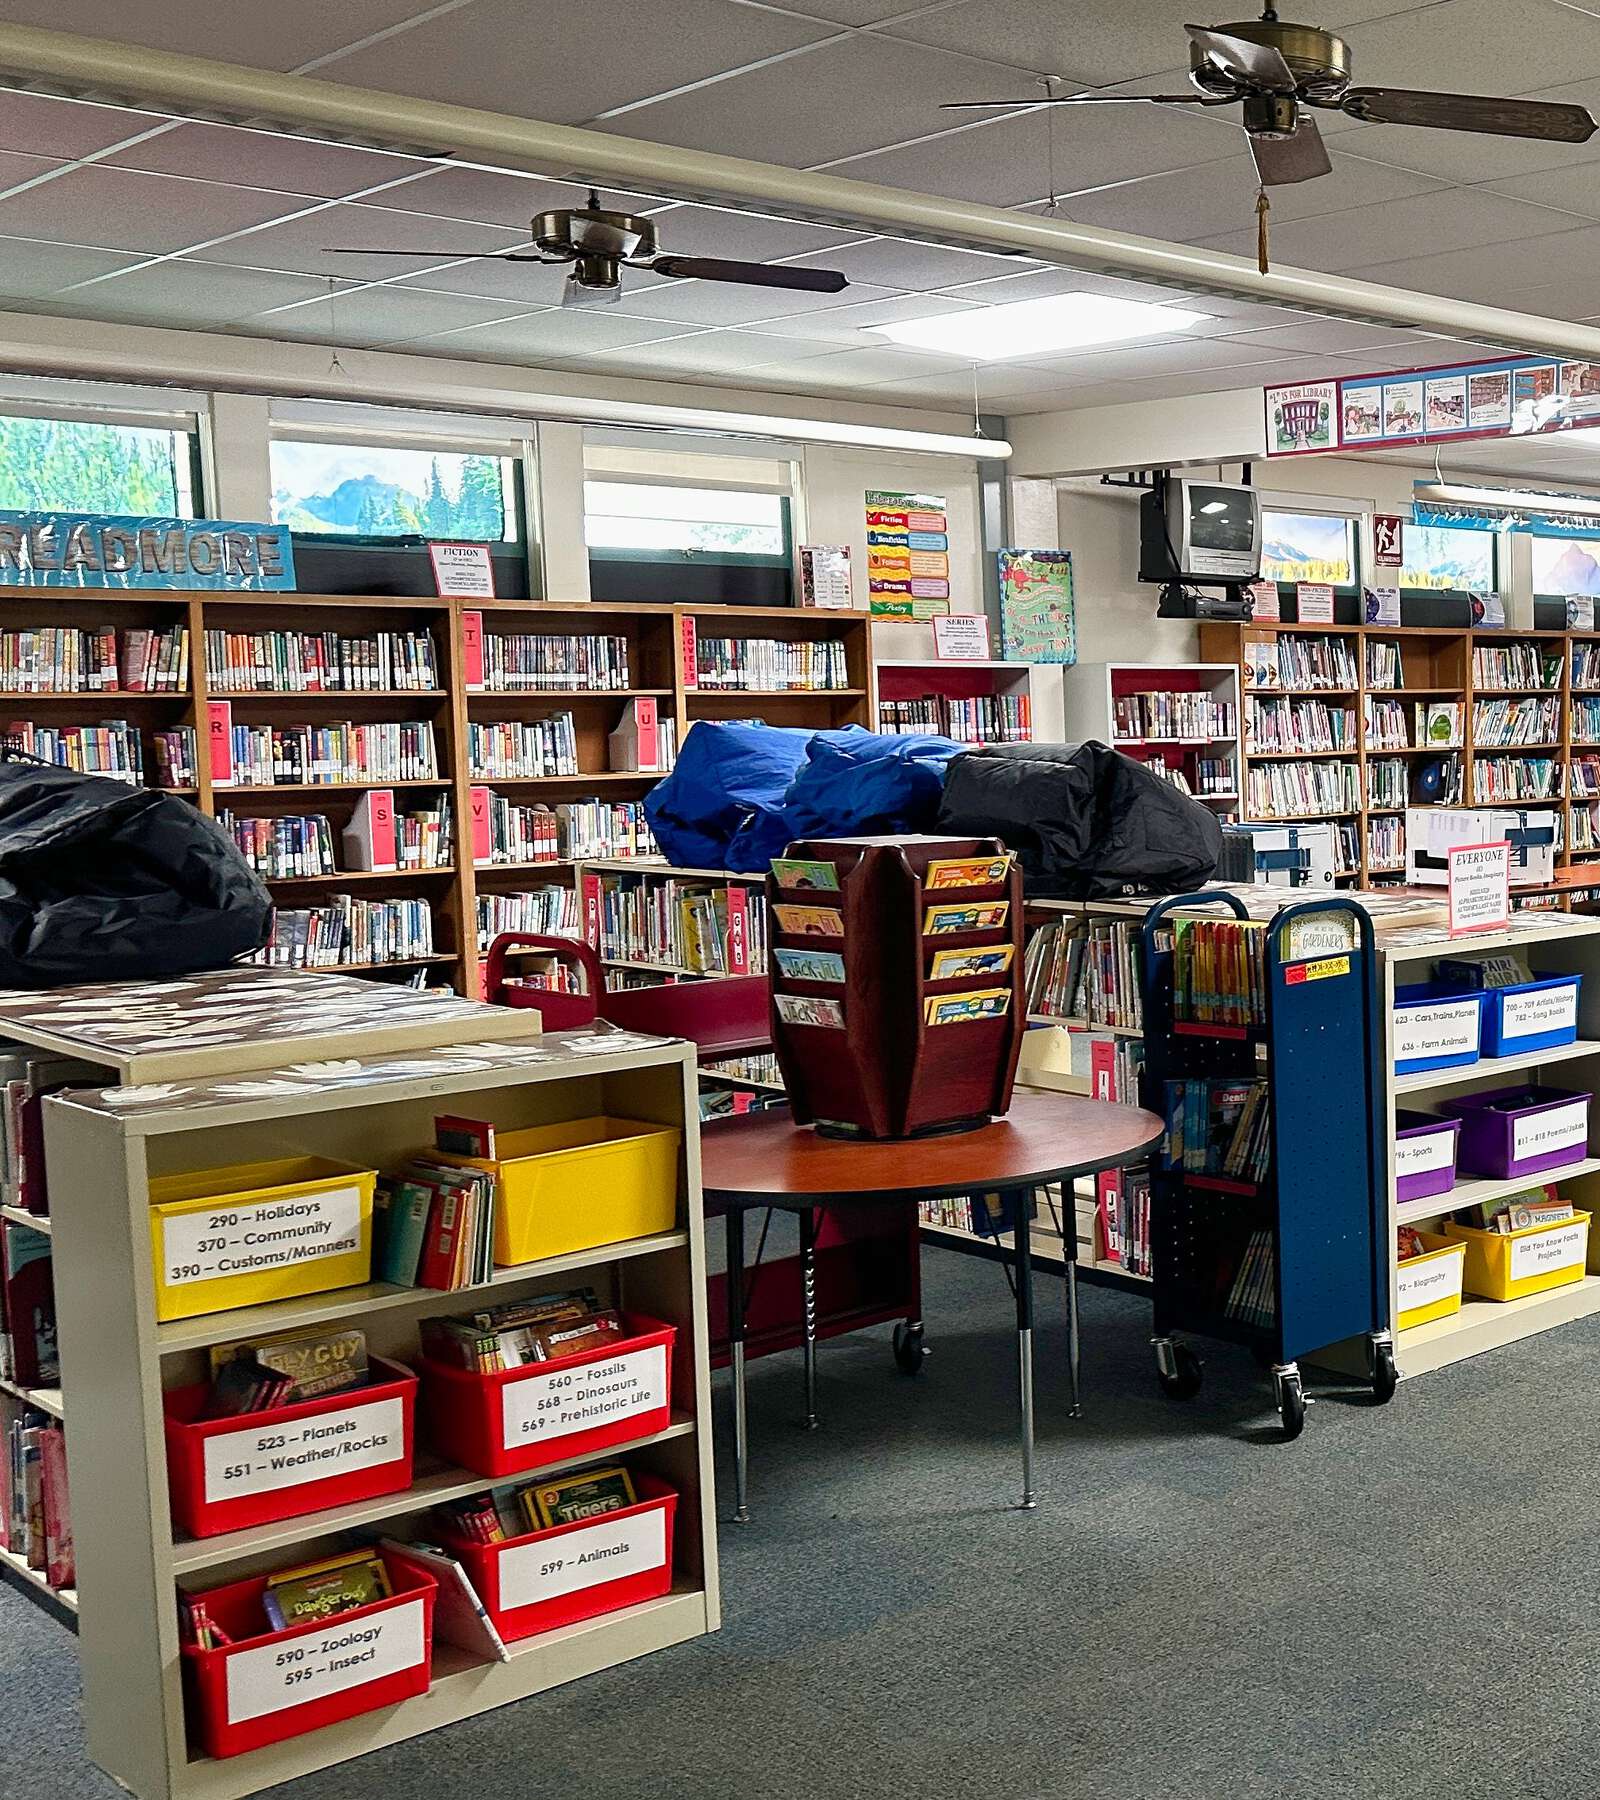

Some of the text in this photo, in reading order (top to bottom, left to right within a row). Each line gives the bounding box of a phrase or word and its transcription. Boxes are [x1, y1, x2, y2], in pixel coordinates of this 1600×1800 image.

[1281, 391, 1288, 399] IS
[1289, 389, 1302, 398] FOR
[1303, 387, 1333, 398] LIBRARY
[881, 516, 903, 524] Fiction
[443, 548, 479, 557] FICTION
[466, 630, 475, 640] T
[211, 721, 222, 733] R
[641, 714, 650, 725] U
[377, 809, 386, 821] S
[473, 805, 482, 816] V
[1456, 849, 1504, 865] EVERYONE
[789, 958, 816, 979] JACK
[784, 1000, 813, 1023] JACK
[1506, 1003, 1518, 1012] 700
[1549, 1007, 1565, 1016] Books
[1395, 1016, 1408, 1025] 623
[1422, 1039, 1439, 1049] Farm
[1441, 1036, 1468, 1047] Animals
[1222, 1093, 1248, 1102] Denti
[1547, 1121, 1585, 1139] Poems/Jokes
[1412, 1146, 1432, 1158] Sports
[209, 1201, 321, 1229] 290 Holidays
[197, 1220, 331, 1254] 370 Community
[1532, 1241, 1544, 1251] You
[1546, 1237, 1562, 1248] Know
[1563, 1232, 1579, 1244] Facts
[171, 1238, 356, 1281] 390 Customs/Manners
[1537, 1248, 1562, 1261] Projects
[1414, 1272, 1446, 1289] Biography
[314, 1336, 361, 1363] GUY
[548, 1361, 626, 1390] 560 Fossils
[537, 1377, 638, 1411] 568 Dinosaurs
[521, 1390, 651, 1432] 569 Prehistoric Life
[257, 1419, 356, 1452] 523 Planets
[224, 1434, 388, 1480] 551 Weather/Rocks
[561, 1496, 621, 1521] Tigers
[540, 1541, 630, 1575] 599 Animals
[276, 1626, 382, 1666] 590 Zoology
[285, 1647, 375, 1684] 595 Insect
